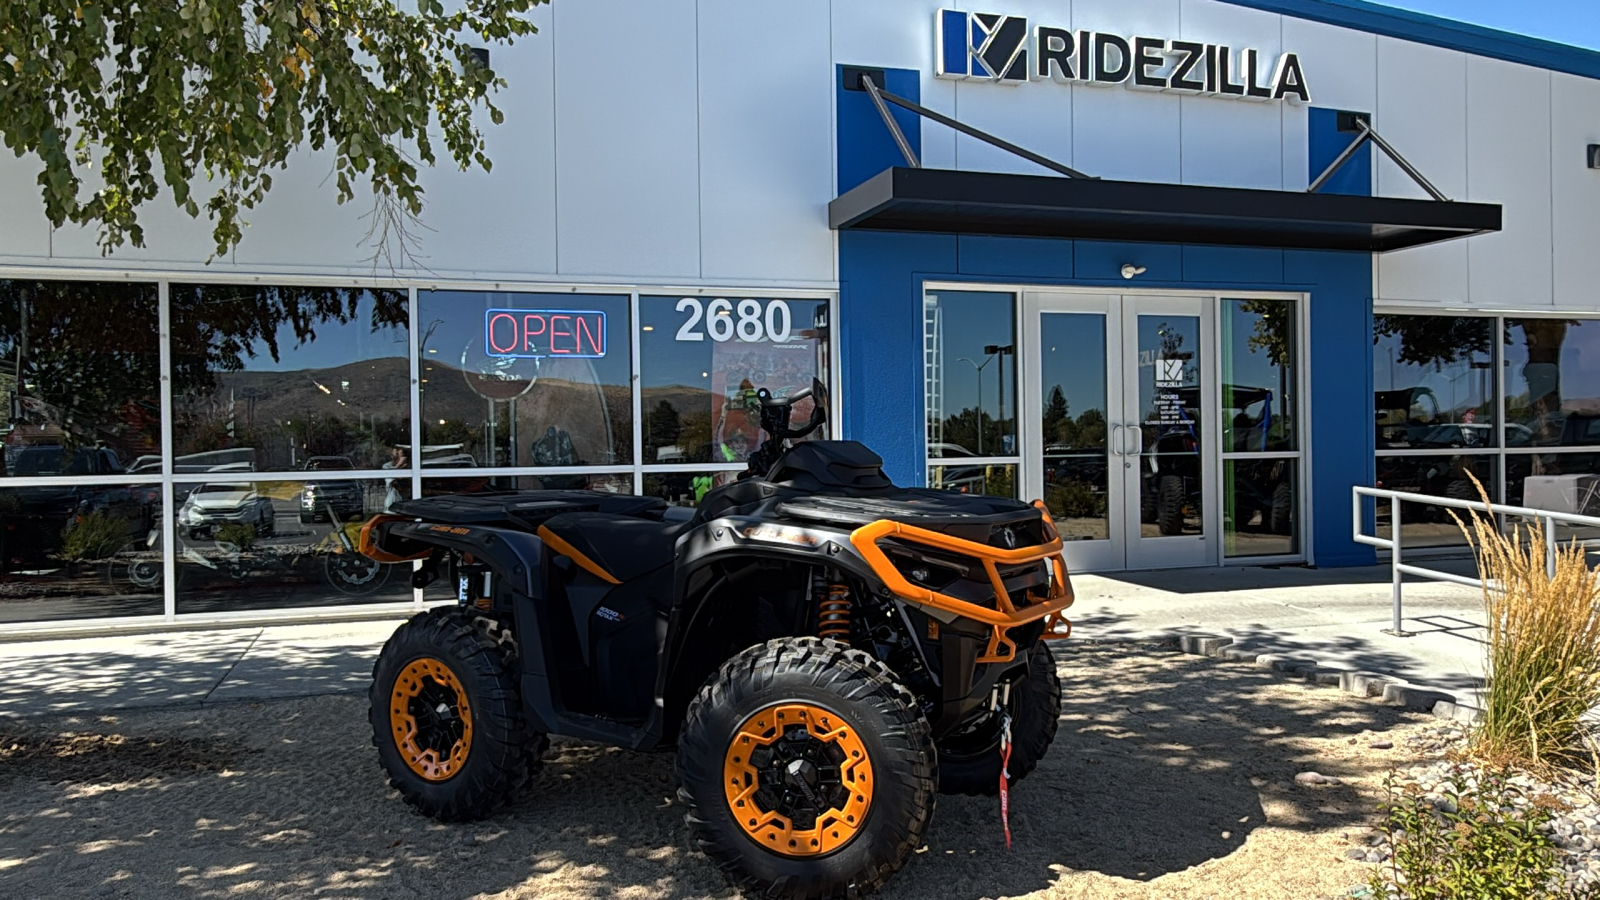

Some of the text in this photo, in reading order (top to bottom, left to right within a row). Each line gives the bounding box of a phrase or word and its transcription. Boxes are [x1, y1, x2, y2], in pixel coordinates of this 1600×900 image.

[1035, 26, 1311, 102] RIDEZILLA
[489, 313, 602, 353] OPEN
[675, 298, 791, 343] 2680
[459, 577, 469, 601] FOX
